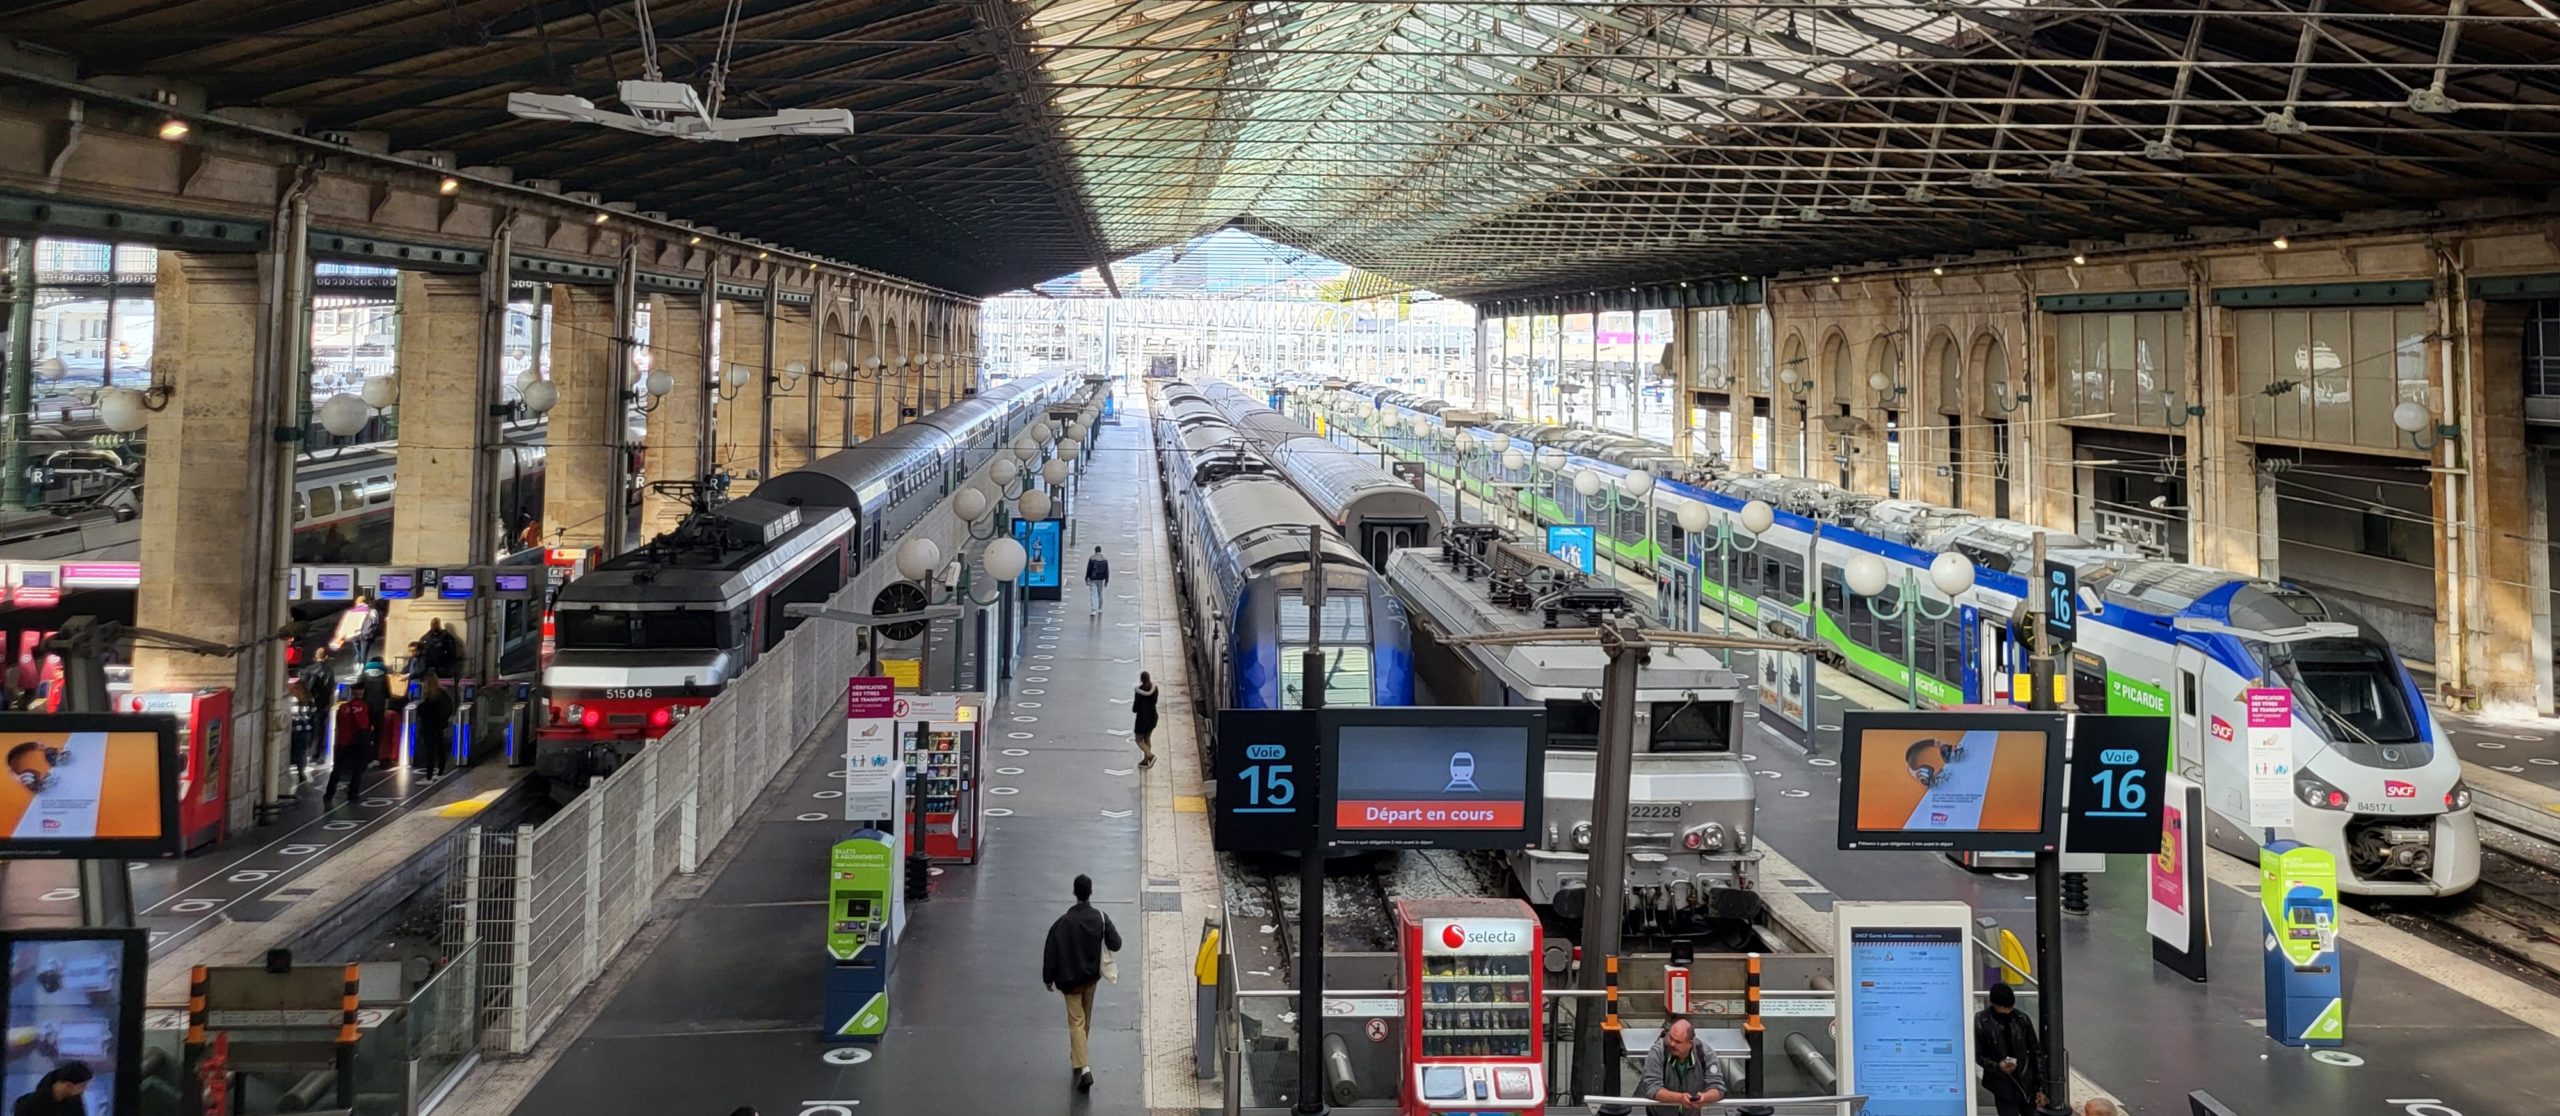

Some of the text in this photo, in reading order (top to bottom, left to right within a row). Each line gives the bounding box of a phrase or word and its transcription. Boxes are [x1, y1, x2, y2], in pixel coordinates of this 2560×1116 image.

[2051, 587, 2070, 623] 16
[606, 688, 653, 699] 515046
[2122, 684, 2165, 712] PICARDIE
[2212, 723, 2233, 738] SNCF
[1252, 746, 1281, 758] Voie
[2105, 751, 2133, 762] Voie
[1238, 765, 1295, 805] 15
[2091, 769, 2146, 810] 16
[2387, 786, 2415, 796] SNCF
[1631, 806, 1681, 818] 22228
[2358, 802, 2396, 812] 84517 L
[1366, 807, 1494, 823] Départ en cours
[1468, 931, 1516, 943] selecta
